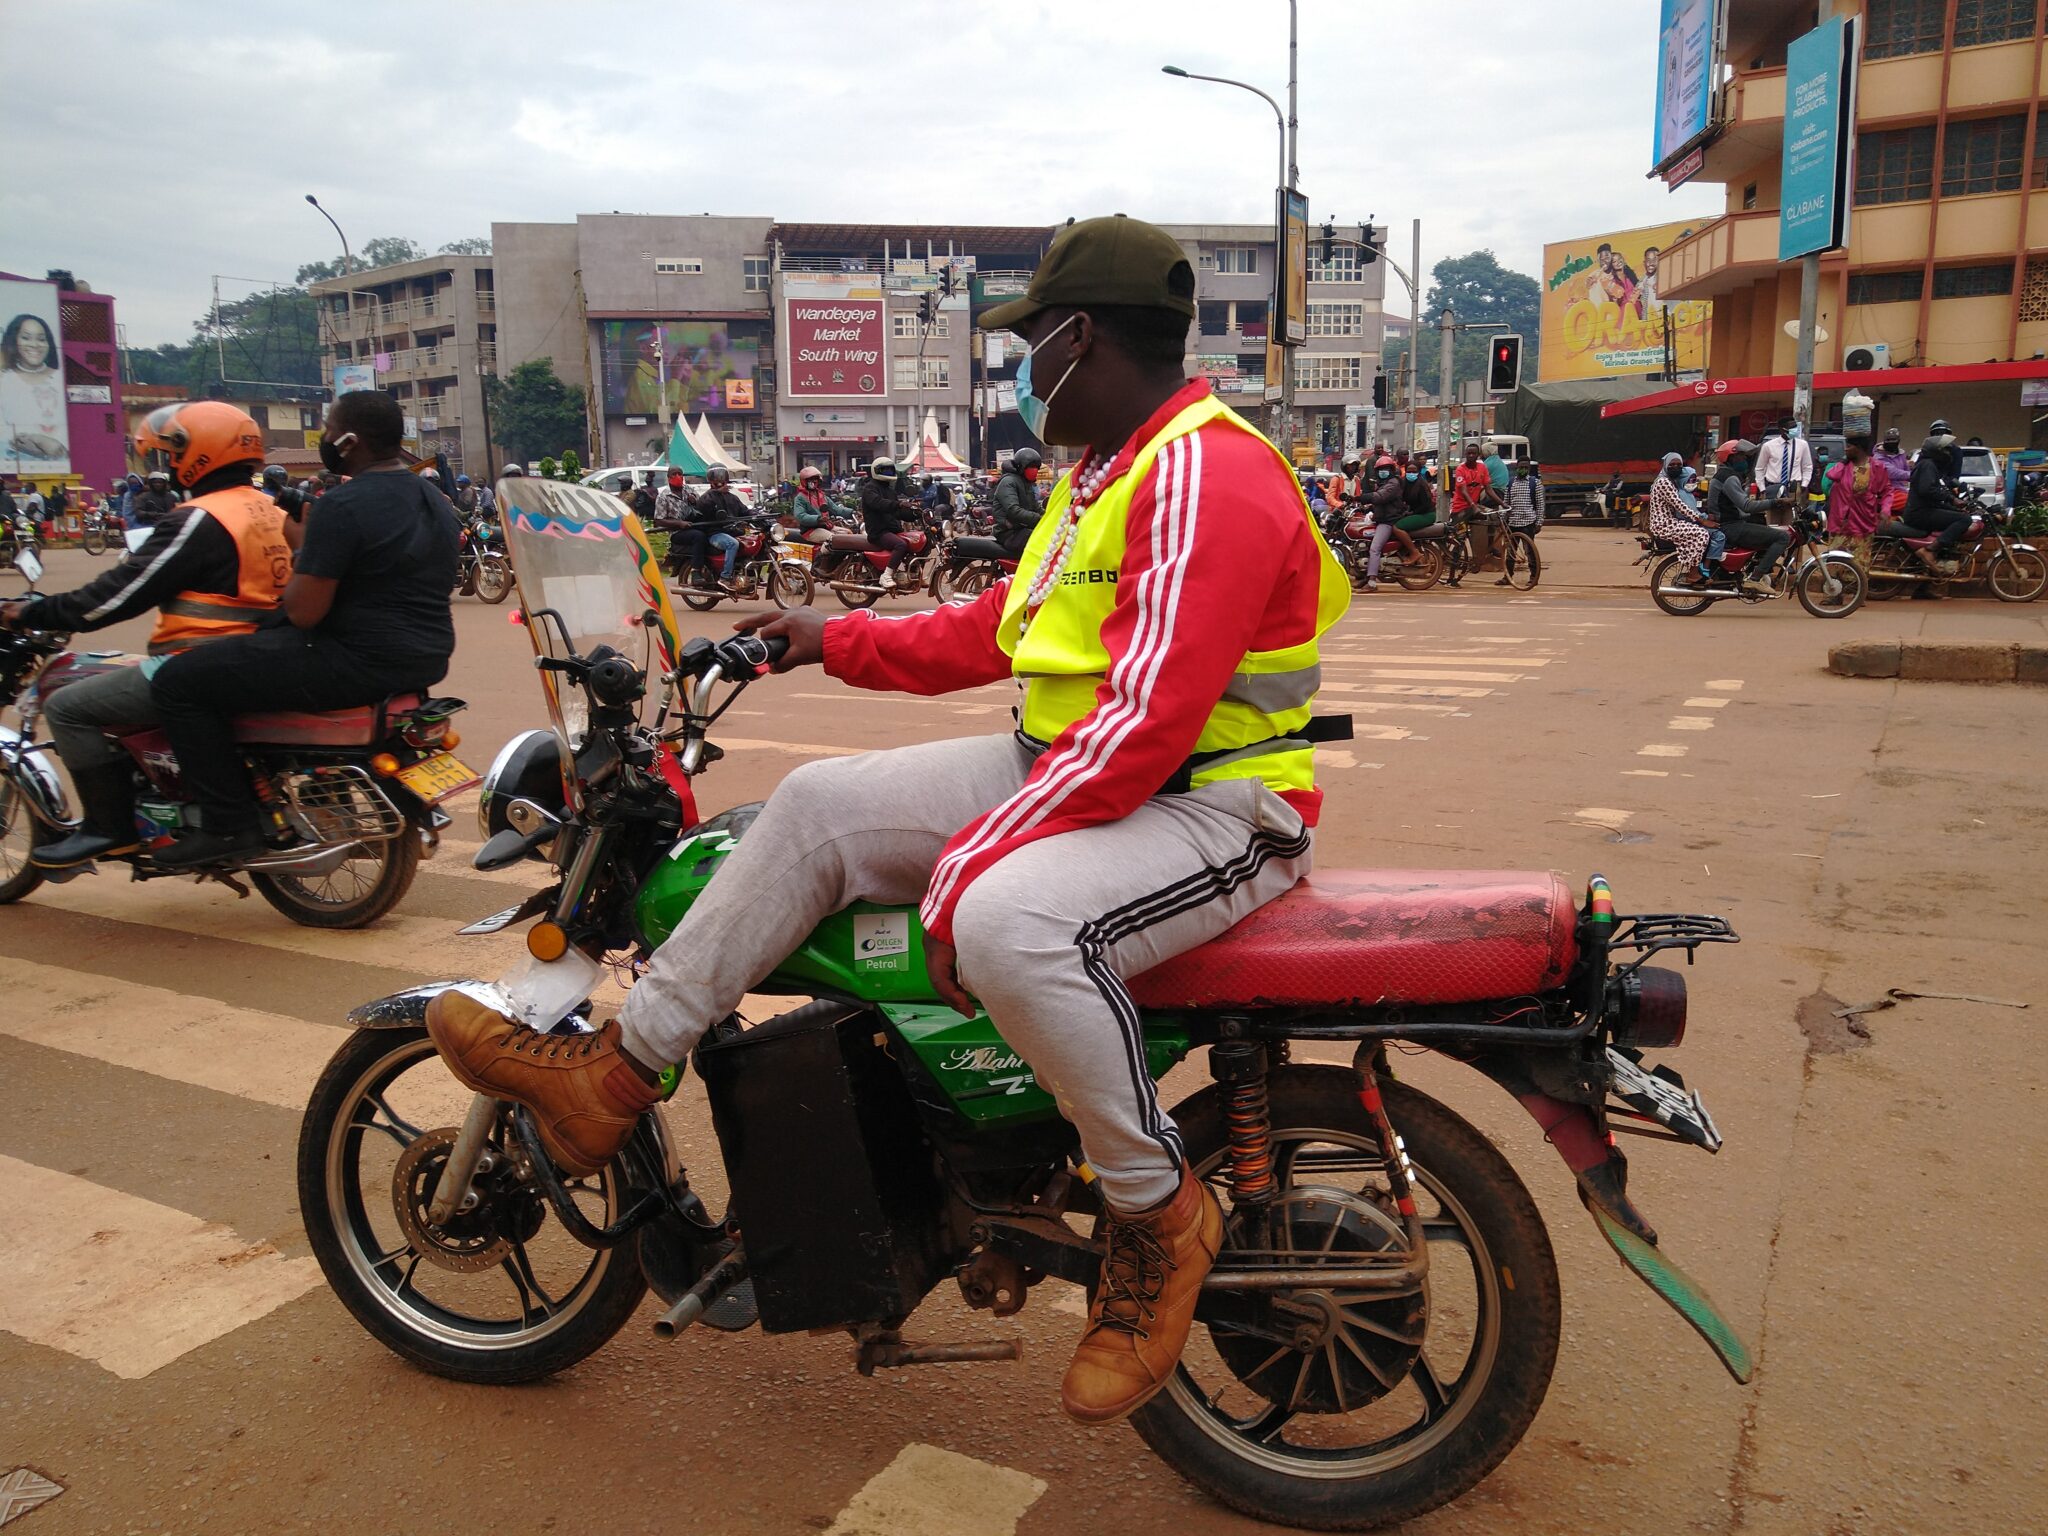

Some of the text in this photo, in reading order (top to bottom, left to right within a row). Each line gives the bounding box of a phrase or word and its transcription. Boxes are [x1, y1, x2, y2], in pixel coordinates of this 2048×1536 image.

[1809, 72, 1828, 89] MORE
[1797, 84, 1826, 106] CLABANE
[1786, 194, 1825, 221] CLABANE
[796, 307, 877, 324] Wandegeya
[813, 327, 861, 341] Market
[798, 348, 840, 361] South
[1596, 353, 1613, 361] Enjoy
[1605, 359, 1629, 367] Mirinda
[1630, 358, 1653, 366] Orange
[866, 959, 897, 969] Petrol
